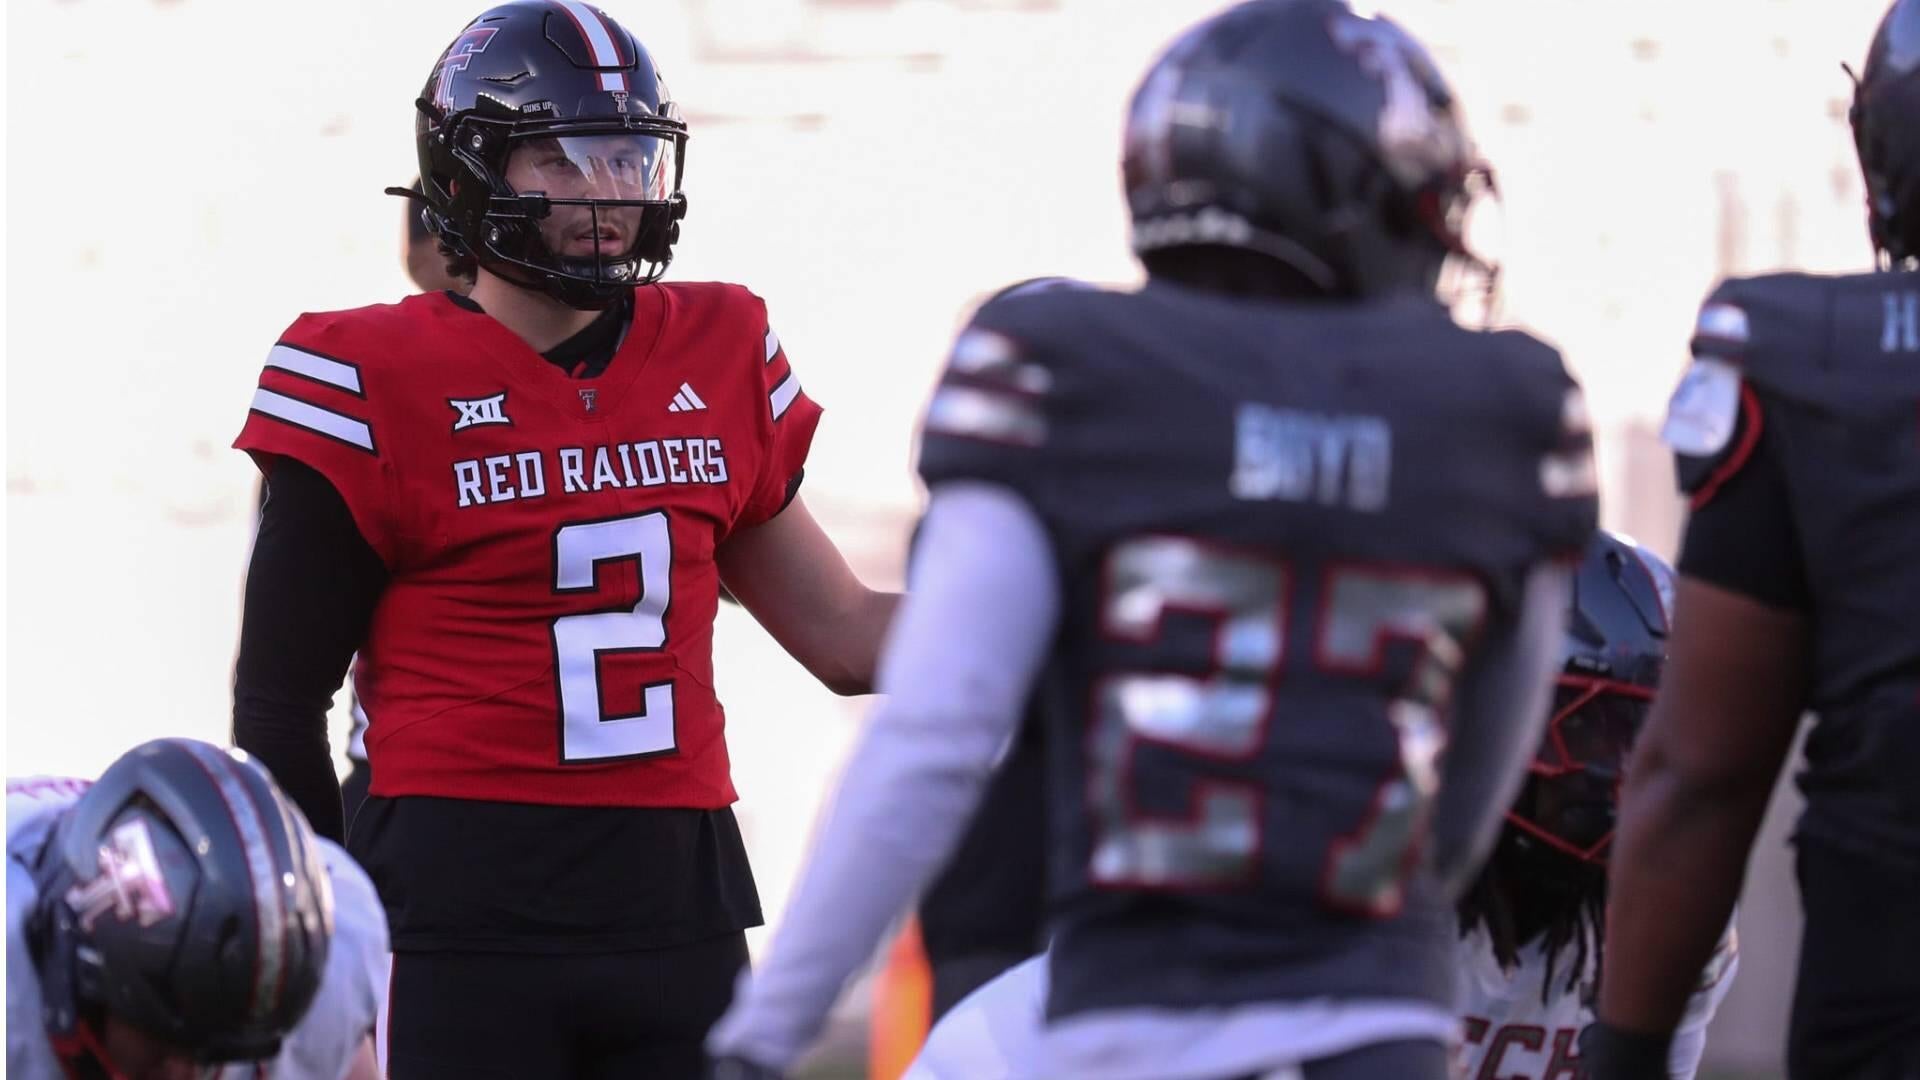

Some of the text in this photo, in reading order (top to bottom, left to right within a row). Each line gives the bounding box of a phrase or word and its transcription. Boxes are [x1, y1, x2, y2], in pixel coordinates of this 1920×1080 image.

[522, 100, 553, 114] GUNS UP
[449, 392, 512, 431] XII
[454, 438, 728, 507] RED RAIDERS
[551, 509, 677, 763] 2
[1089, 535, 1489, 917] 27
